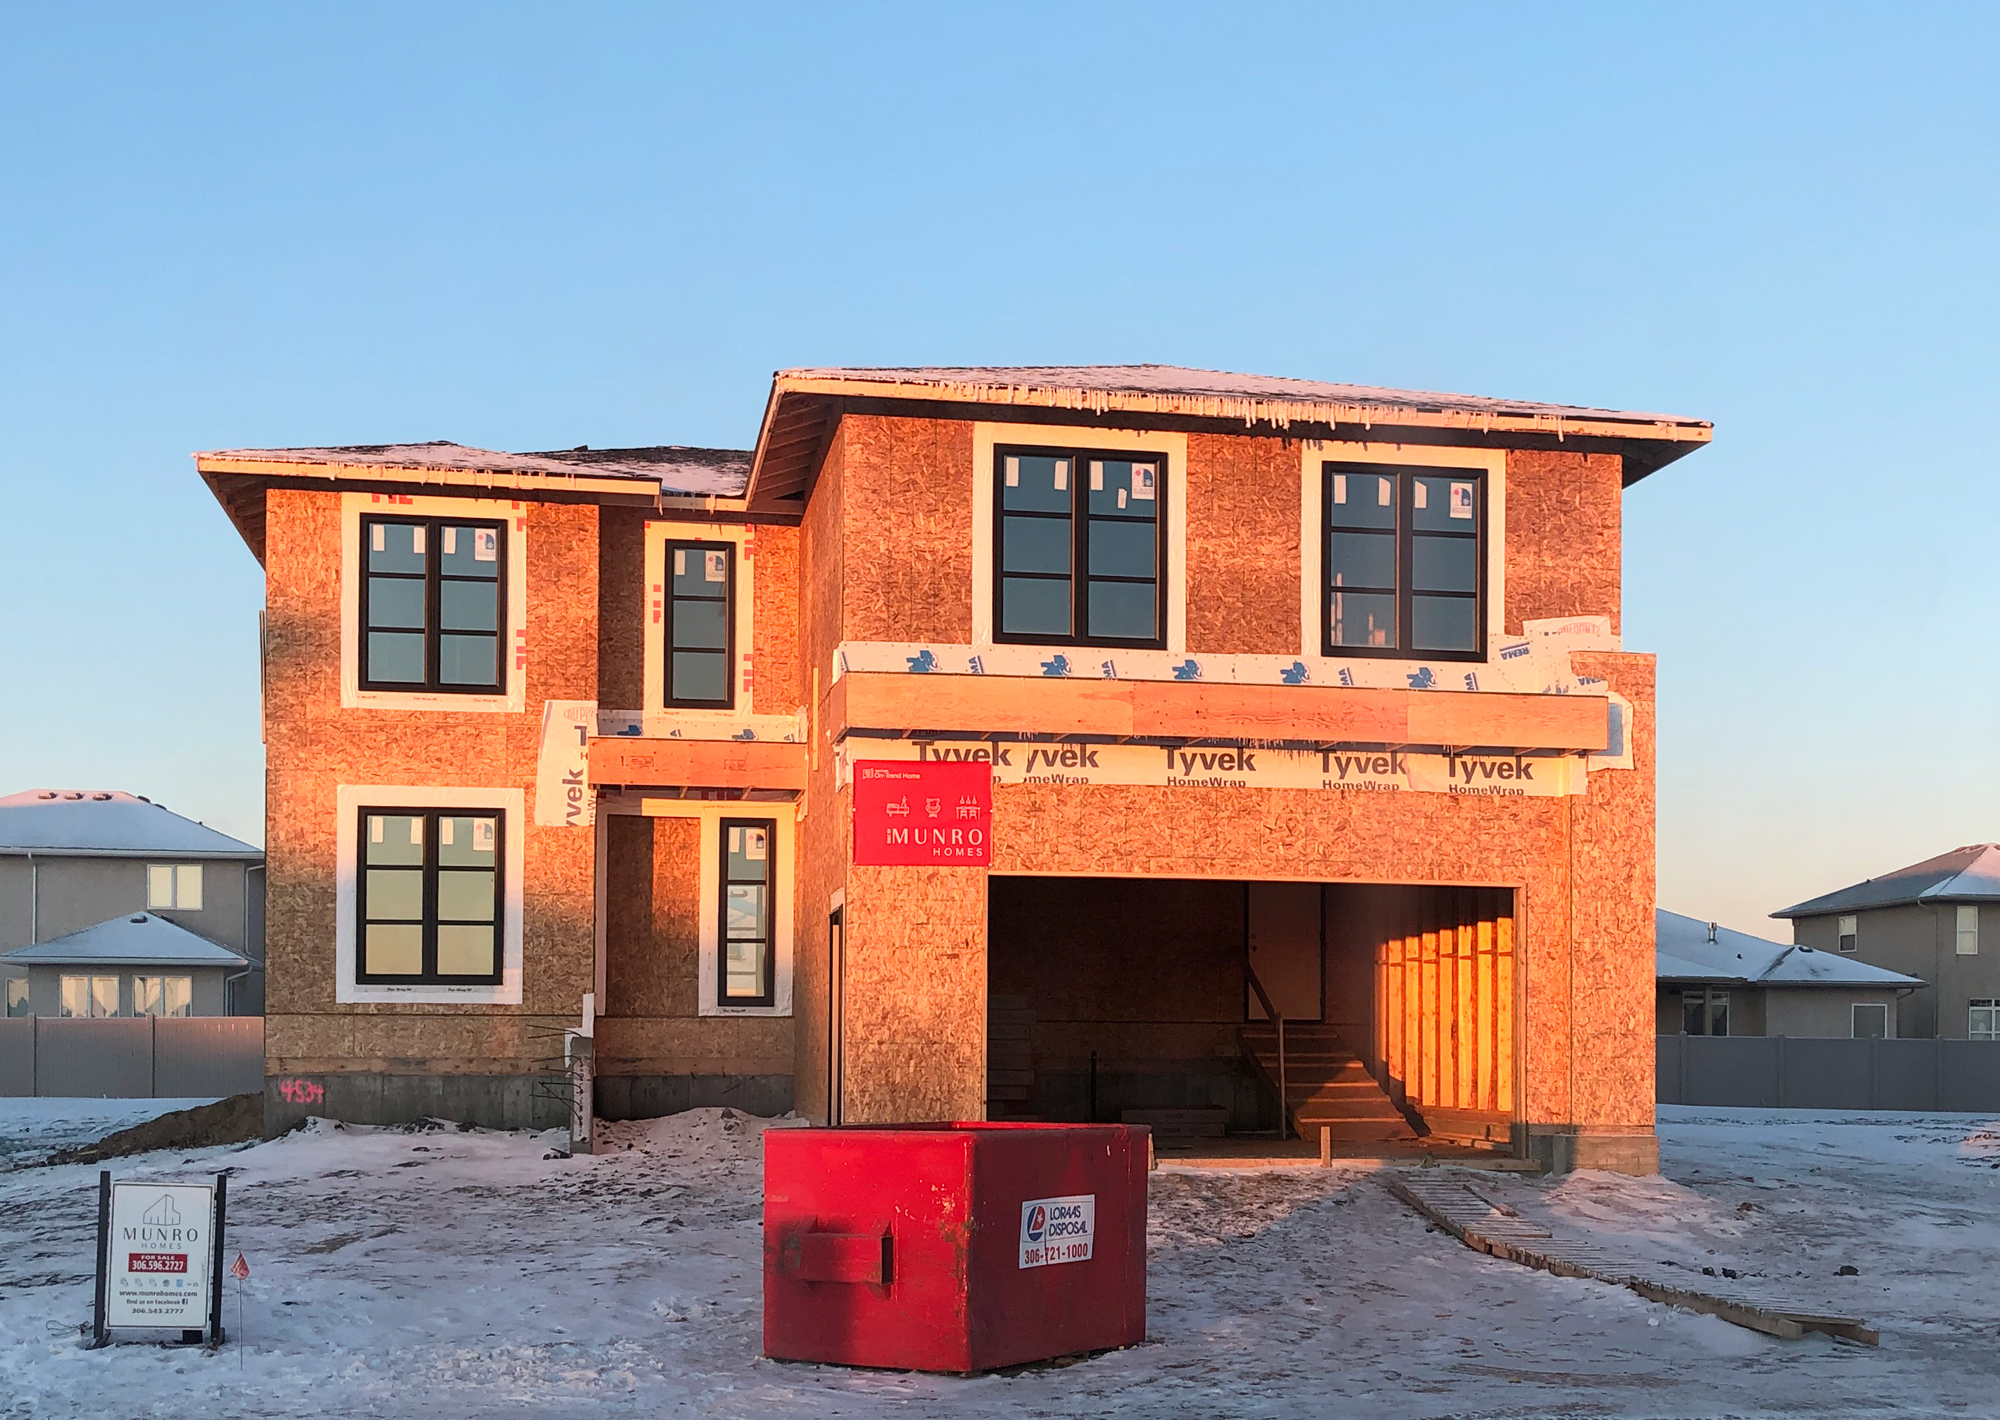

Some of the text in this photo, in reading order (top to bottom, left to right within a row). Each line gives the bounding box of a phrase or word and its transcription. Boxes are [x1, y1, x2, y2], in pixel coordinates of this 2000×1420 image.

[1026, 743, 1099, 773] yvek
[1160, 745, 1256, 776] Tyvek
[1317, 749, 1407, 780] Tyvek
[1444, 754, 1533, 784] Tyvek
[1167, 777, 1246, 788] HomeWrap
[1322, 780, 1400, 791] HomeWrap
[1448, 784, 1524, 796] HomeWrap
[892, 828, 983, 846] MUNRO
[933, 848, 983, 857] HOMES
[1050, 1205, 1081, 1220] LORAAS
[123, 1227, 198, 1242] MUNRO
[1049, 1221, 1088, 1237] DISPOSAL
[141, 1242, 182, 1250] HOMES
[1024, 1243, 1088, 1264] 306-721-1000
[131, 1261, 184, 1270] 306.596.2727
